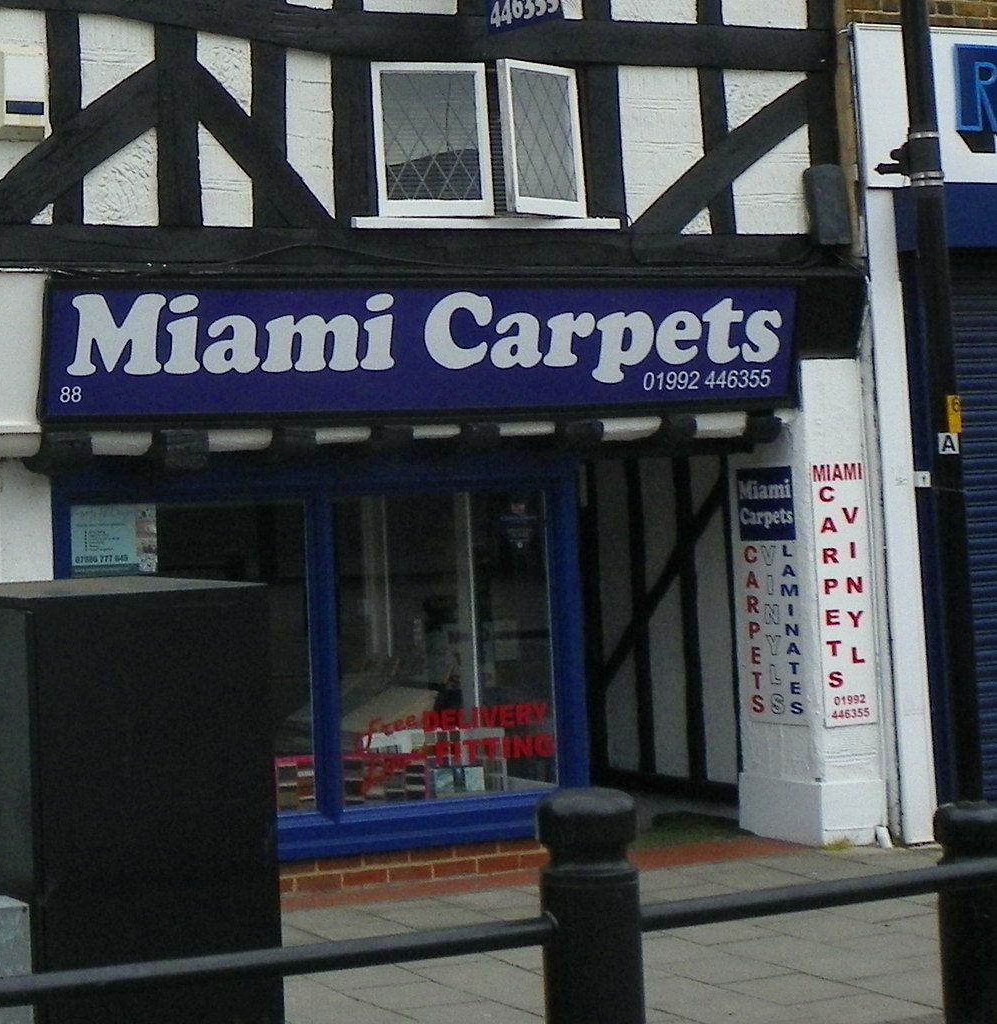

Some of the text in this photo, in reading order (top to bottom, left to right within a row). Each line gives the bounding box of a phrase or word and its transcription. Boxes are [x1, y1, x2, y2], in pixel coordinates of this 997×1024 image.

[67, 291, 782, 384] Miami Carpets
[643, 368, 772, 391] 01992 446355
[59, 385, 82, 403] 88
[942, 434, 956, 452] A
[812, 462, 863, 482] MIAMI
[738, 478, 791, 500] Miami
[740, 507, 794, 529] Carpets
[818, 485, 844, 688] CARPETS
[841, 506, 866, 664] VINYL
[744, 545, 765, 714] CARPETS
[780, 544, 804, 715] LAMINATES
[833, 693, 866, 706] 01992
[422, 702, 547, 732] DELIVERY
[831, 707, 870, 720] 446355
[435, 731, 555, 766] FITTING
